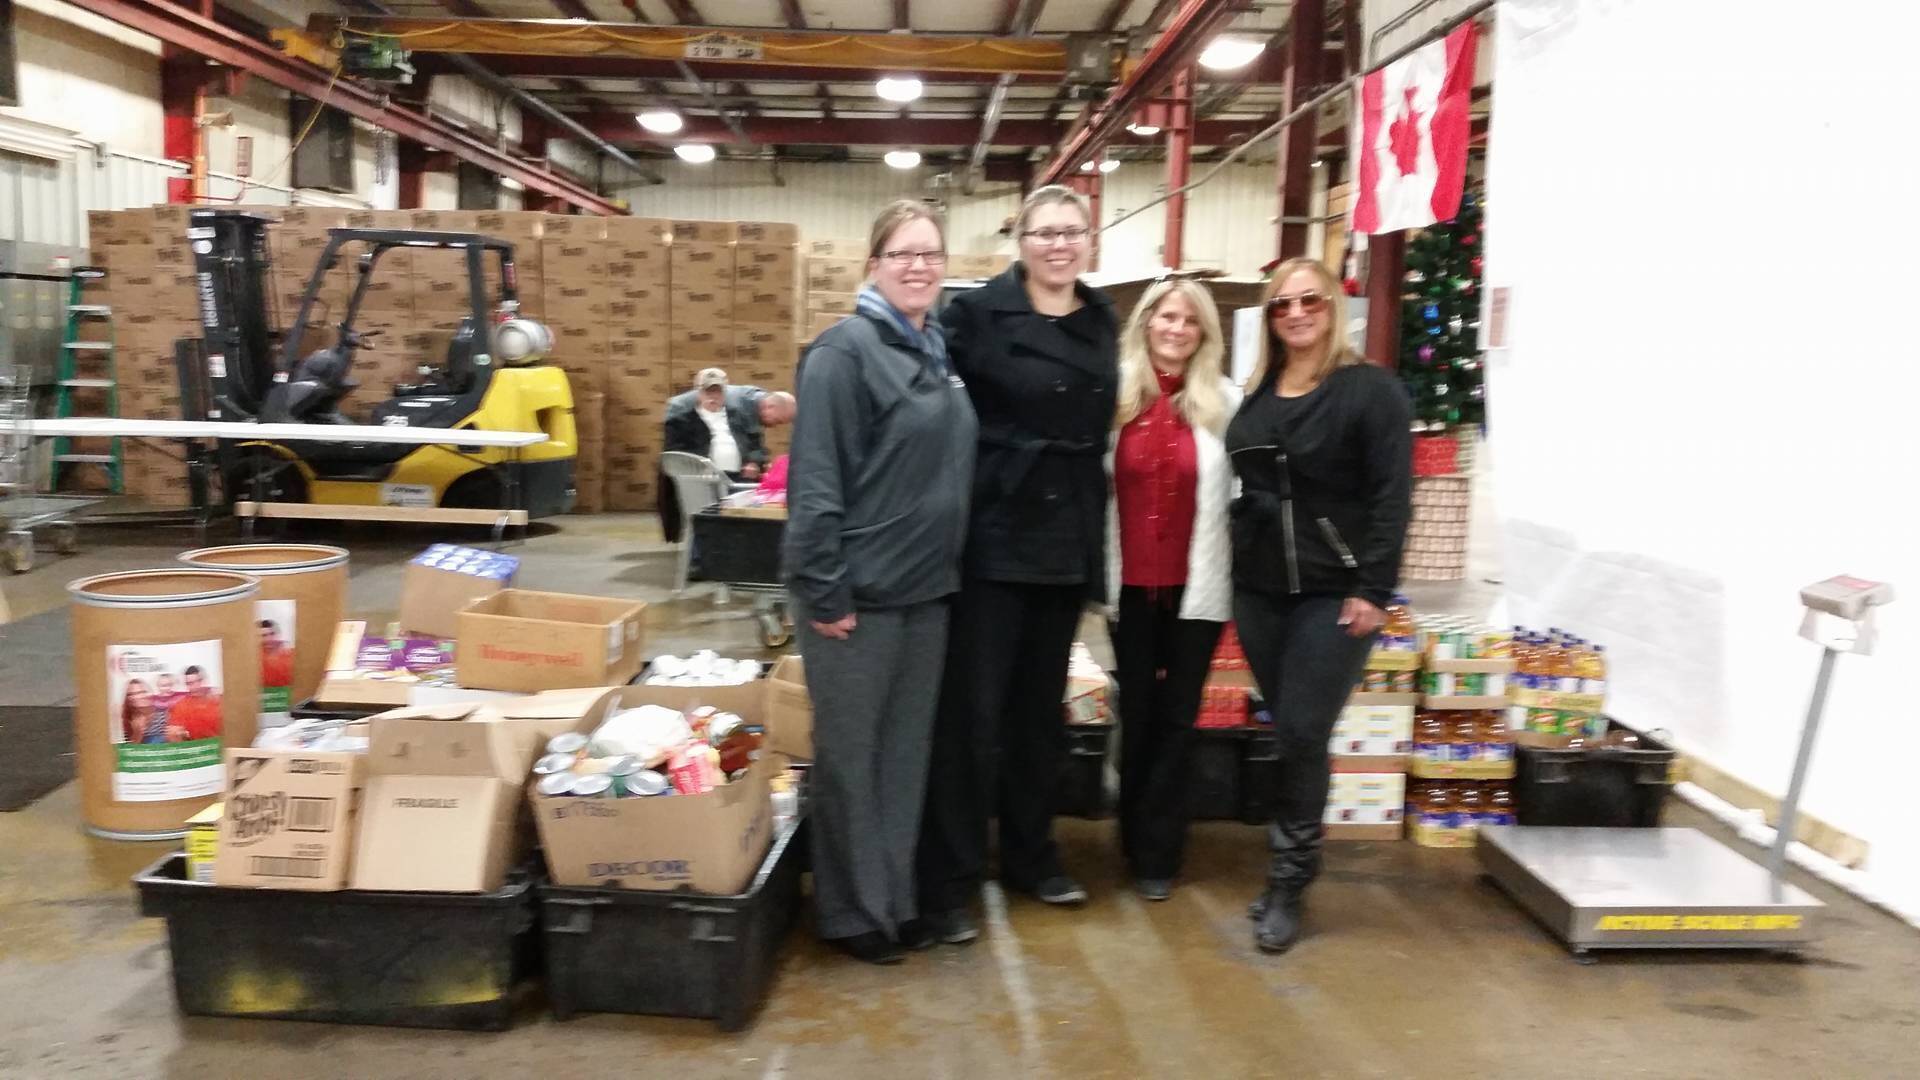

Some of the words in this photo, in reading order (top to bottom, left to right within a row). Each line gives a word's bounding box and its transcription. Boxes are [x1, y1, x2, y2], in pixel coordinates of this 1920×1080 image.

[197, 272, 219, 327] KOMATSU
[480, 643, 585, 667] Honeywell
[392, 797, 460, 809] FRAGILE
[587, 859, 689, 878] DECOR
[1684, 914, 1750, 930] SCALE
